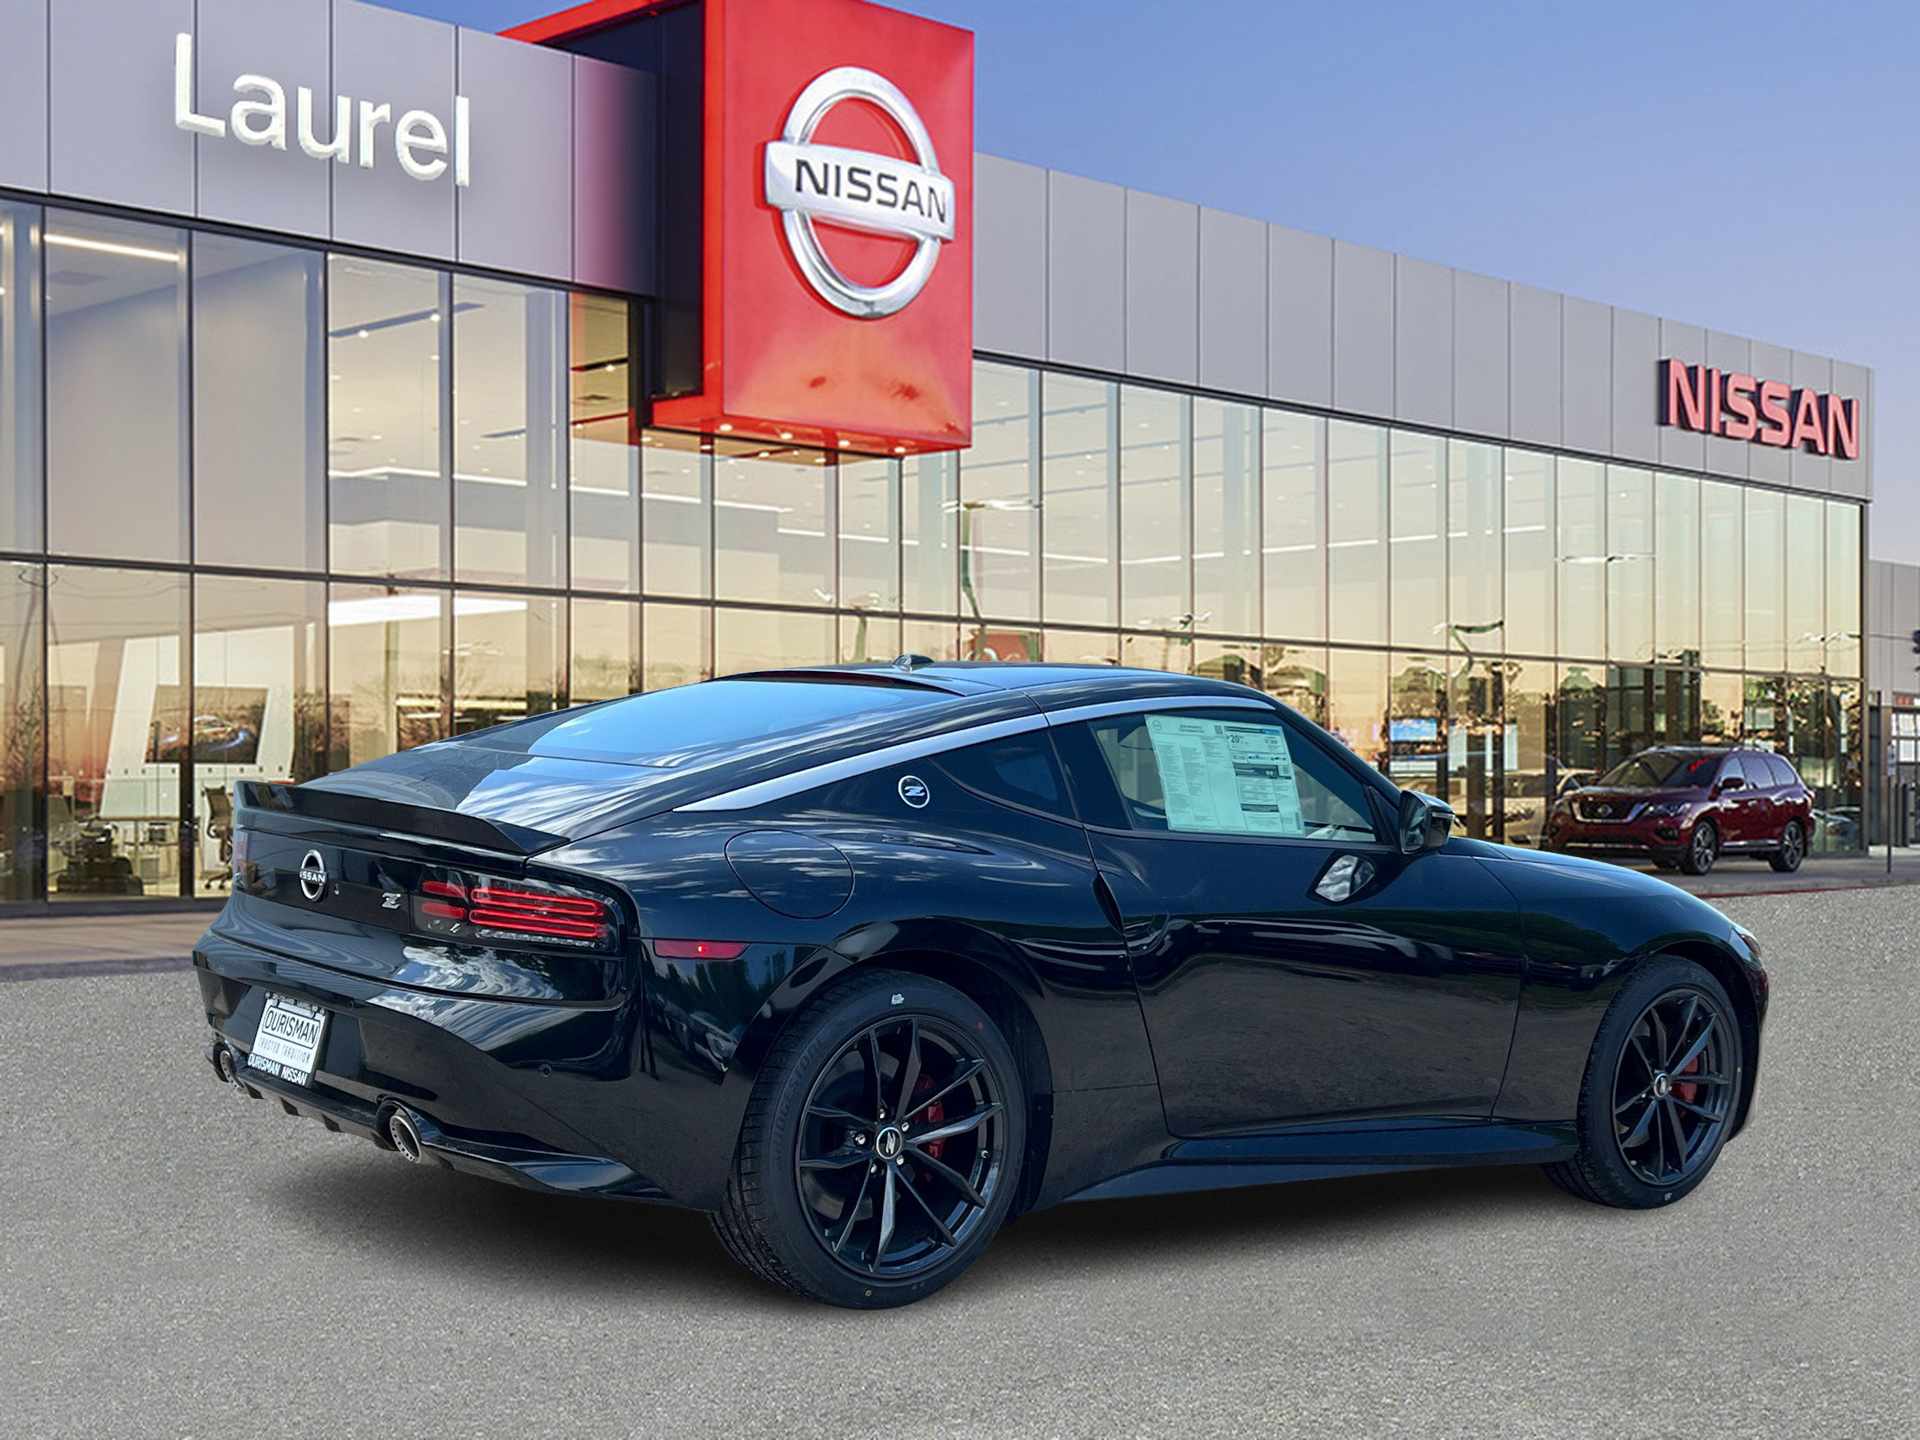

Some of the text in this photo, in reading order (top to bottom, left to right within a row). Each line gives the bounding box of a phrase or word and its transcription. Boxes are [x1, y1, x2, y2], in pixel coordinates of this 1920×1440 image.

[175, 32, 470, 188] Laurel
[794, 157, 947, 224] NISSAN
[1658, 357, 1860, 460] NISSAN
[904, 785, 926, 797] Z
[299, 869, 326, 884] ISSAN
[381, 892, 402, 910] Z
[264, 1010, 320, 1045] OURISMAN
[258, 1036, 312, 1064] TRUSTED TRADITION
[247, 1053, 308, 1087] OURISMAN NISSAN
